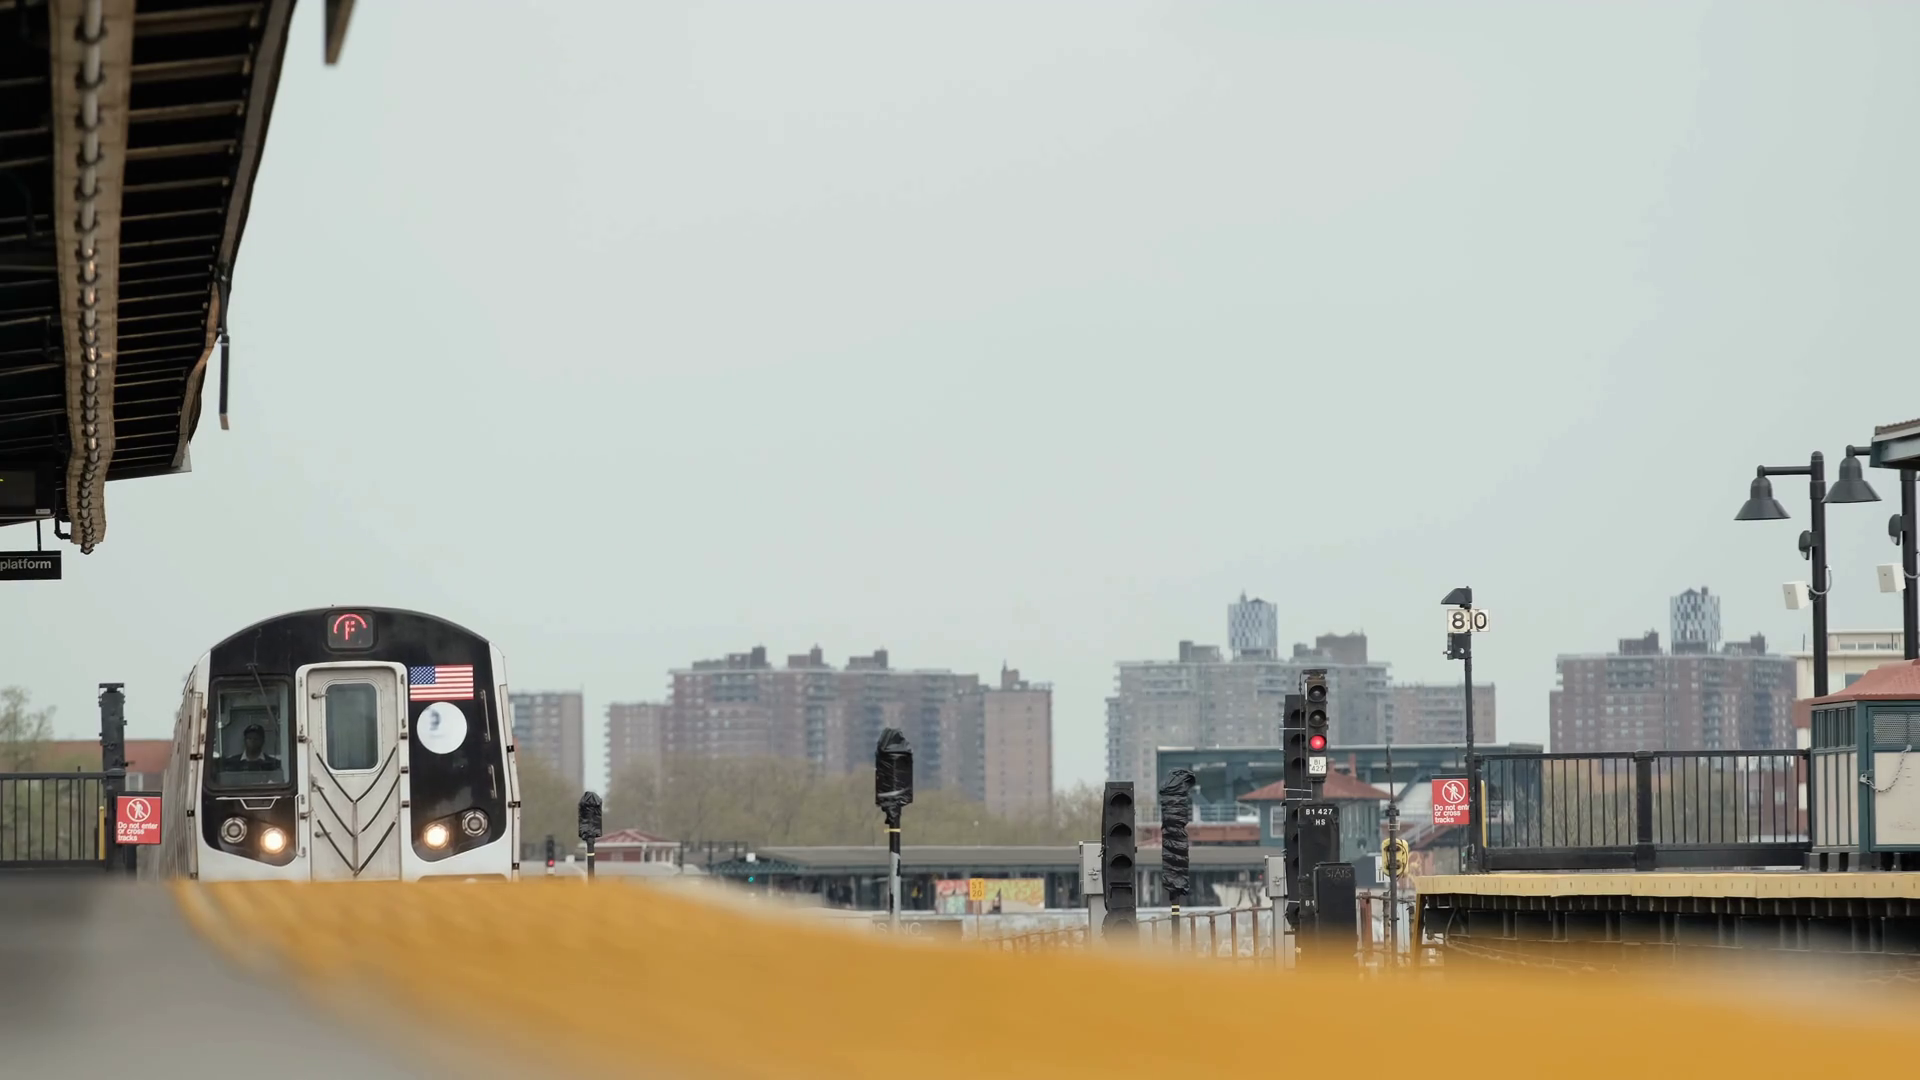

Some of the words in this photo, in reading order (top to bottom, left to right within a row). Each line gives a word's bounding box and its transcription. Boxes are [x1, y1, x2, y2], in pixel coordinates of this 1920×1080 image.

[0, 559, 51, 571] platform
[1452, 612, 1465, 629] 8
[345, 620, 355, 640] F
[117, 821, 128, 829] Do
